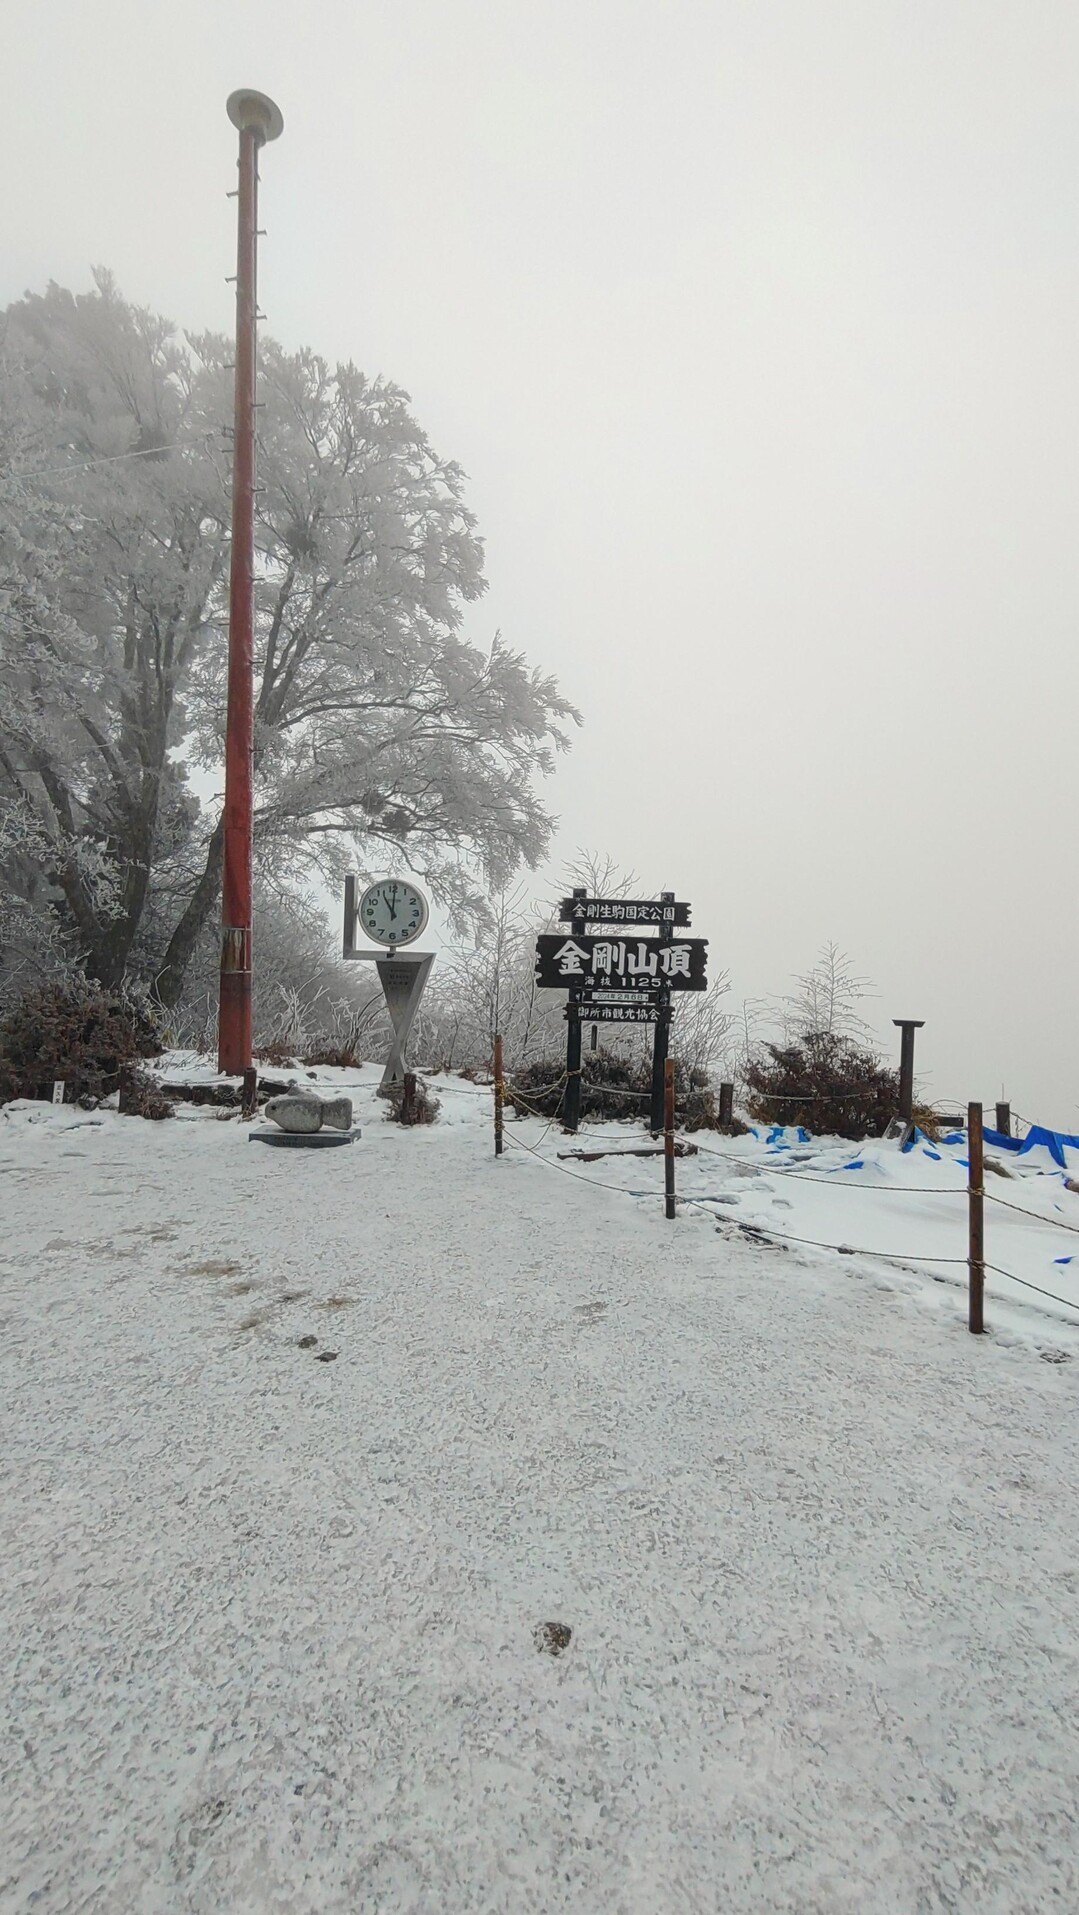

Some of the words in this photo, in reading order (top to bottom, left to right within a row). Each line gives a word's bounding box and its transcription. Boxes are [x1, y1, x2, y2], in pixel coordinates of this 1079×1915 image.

[388, 884, 398, 894] 12
[366, 908, 374, 916] 9
[412, 909, 420, 917] 3
[572, 903, 676, 921] 金剛生駒国定公園
[408, 920, 416, 928] 4
[388, 932, 396, 940] 6
[401, 929, 409, 937] 5
[552, 939, 693, 978] 金剛山頂
[577, 1006, 660, 1021] 御所市観光協会
